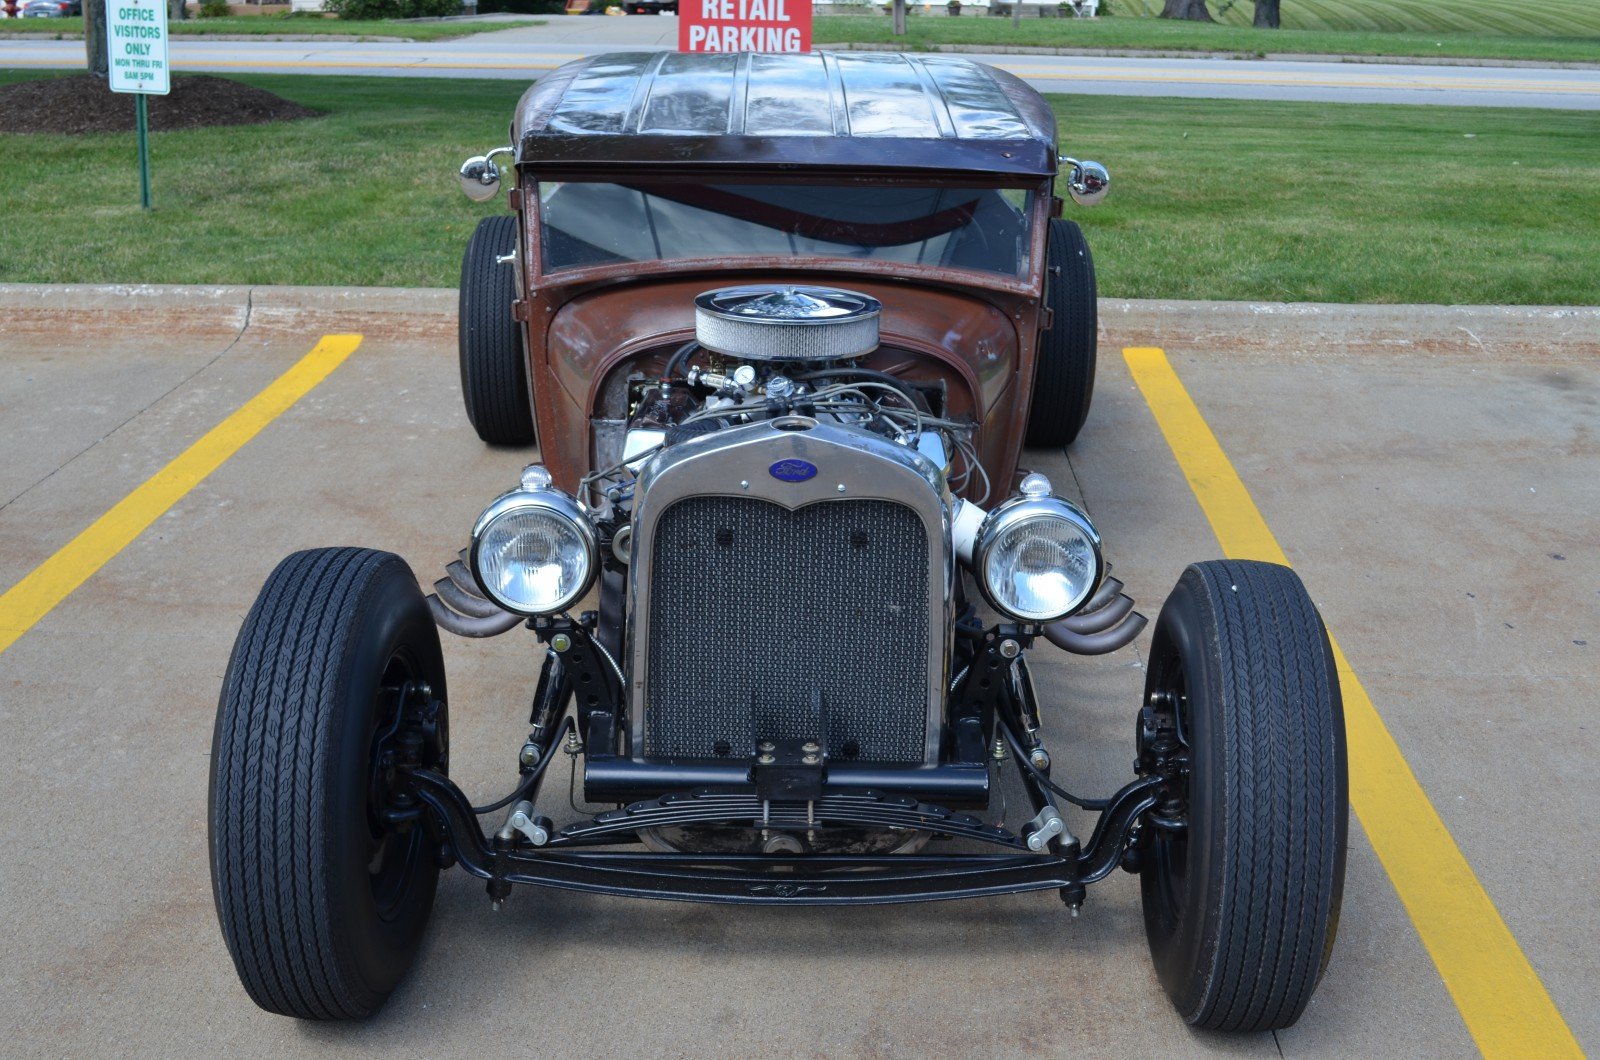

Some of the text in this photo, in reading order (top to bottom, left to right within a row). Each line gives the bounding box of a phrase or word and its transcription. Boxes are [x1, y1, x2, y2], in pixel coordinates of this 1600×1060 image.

[119, 8, 155, 21] OFFICE
[114, 25, 161, 39] VISITORS
[689, 25, 801, 52] PARKING
[125, 43, 151, 55] ONLY
[115, 58, 163, 69] MON THRU FRI
[140, 72, 154, 80] 5PM
[776, 462, 810, 476] Ford
